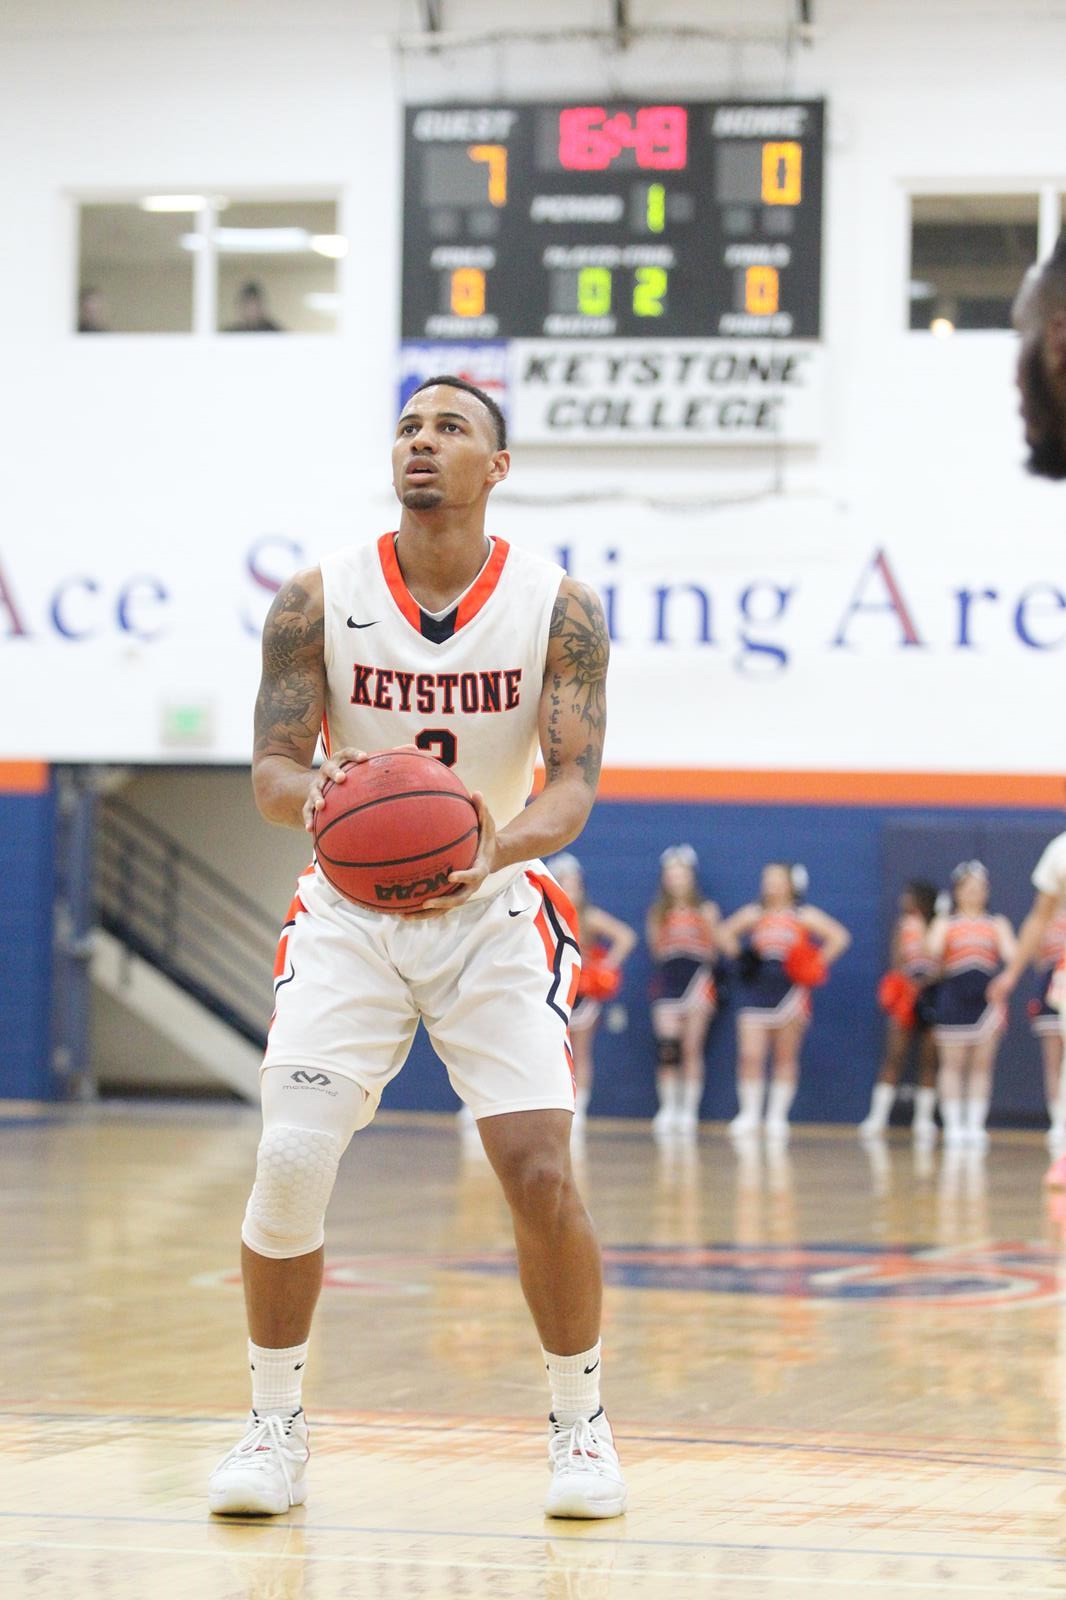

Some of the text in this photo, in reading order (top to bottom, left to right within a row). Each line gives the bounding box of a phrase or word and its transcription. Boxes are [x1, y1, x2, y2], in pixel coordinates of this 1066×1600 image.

[467, 144, 507, 207] 7
[761, 141, 802, 205] 0
[523, 352, 806, 386] KEYSTONE
[545, 396, 784, 433] COLLEGE
[350, 663, 522, 714] KEYSTONE
